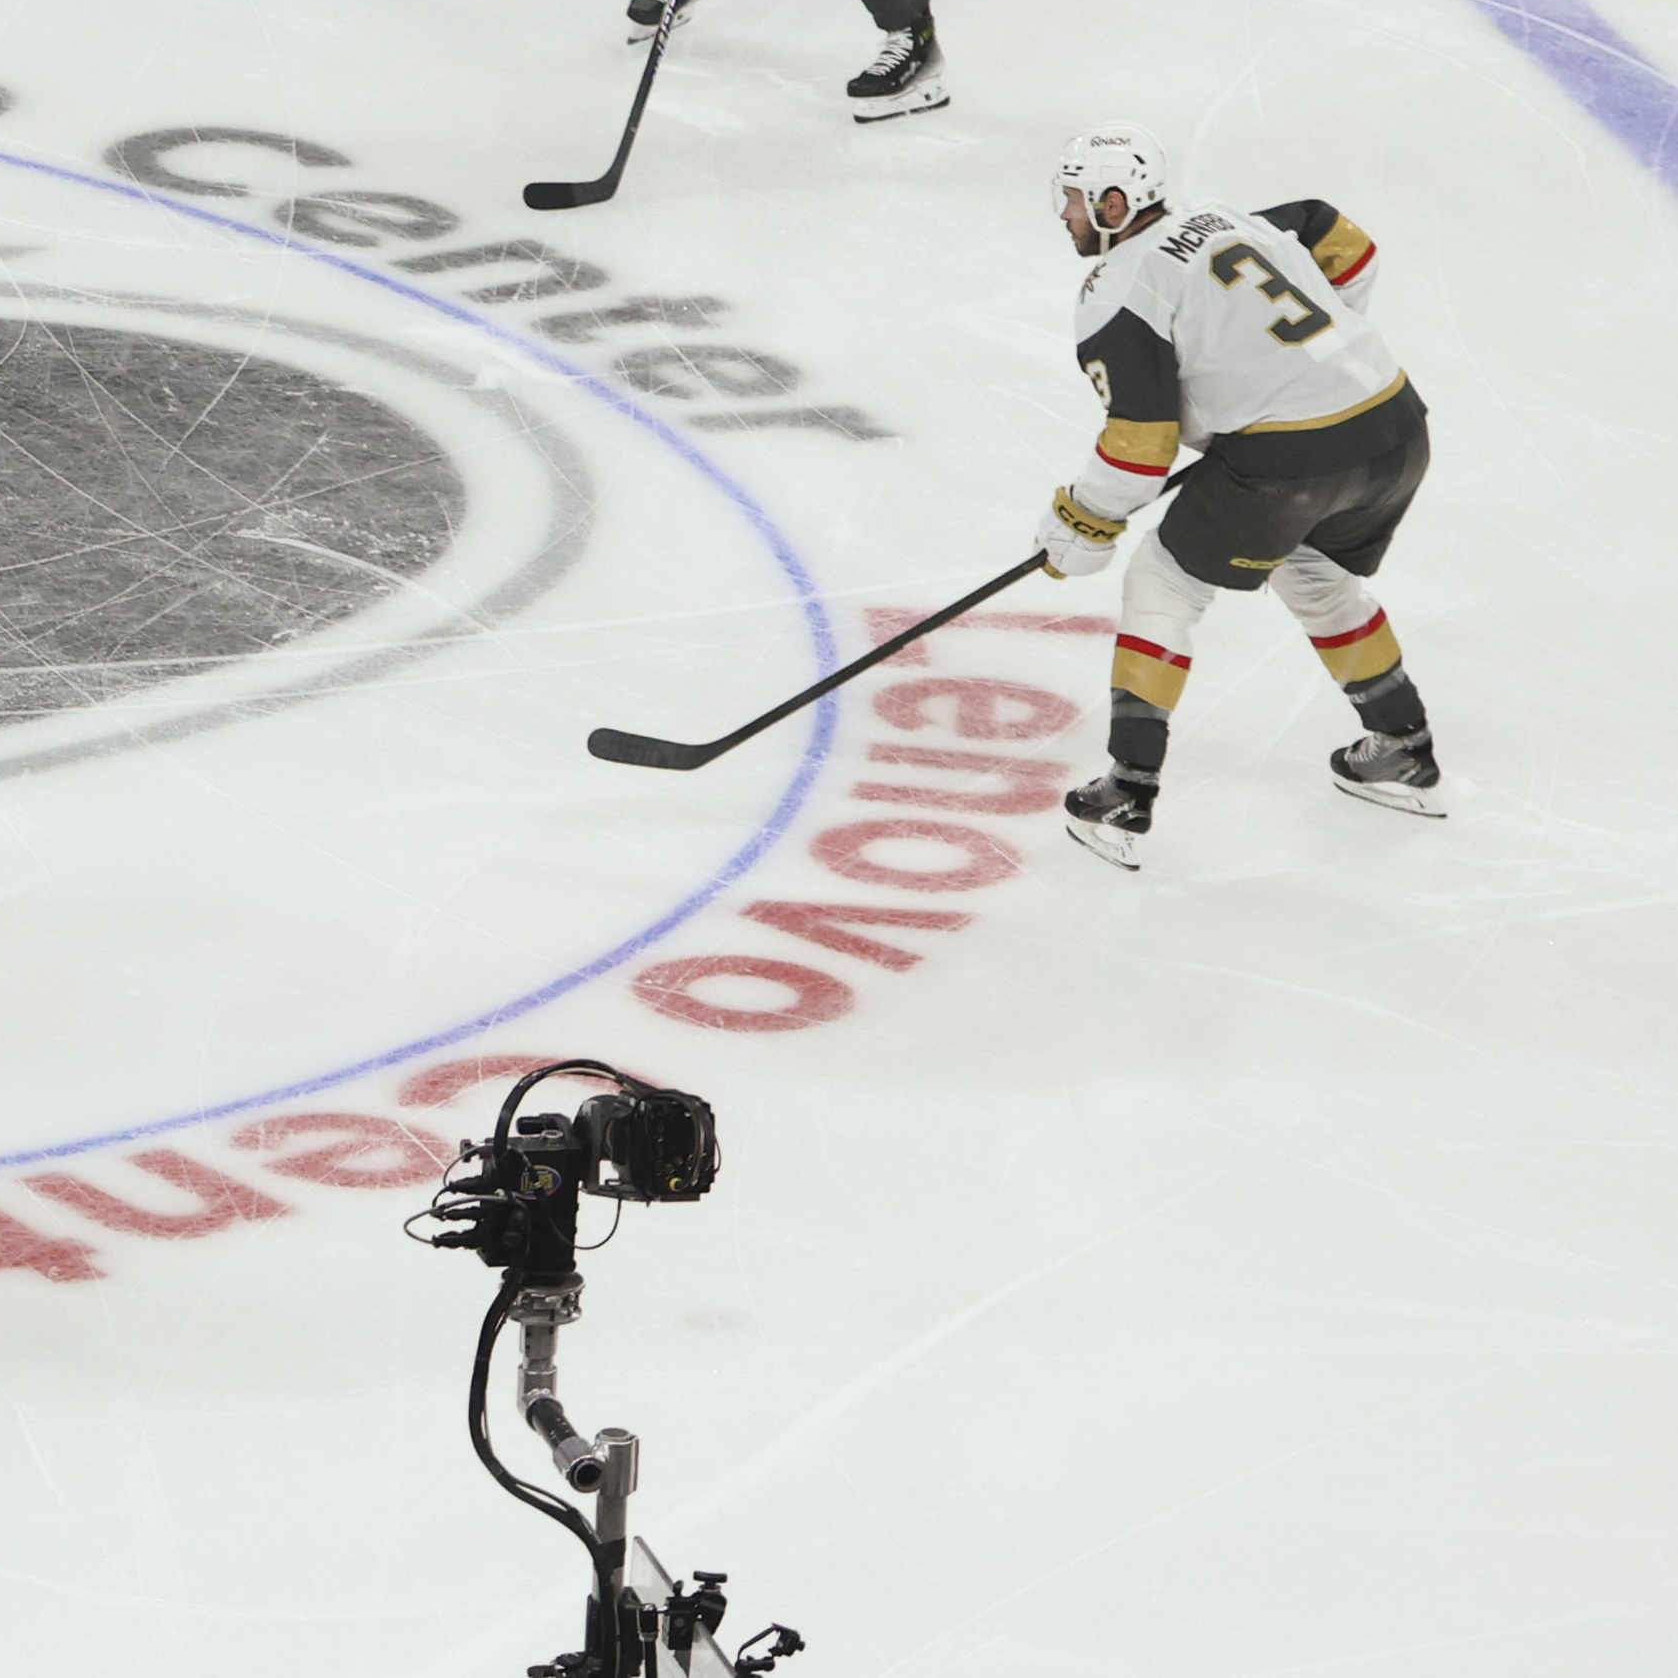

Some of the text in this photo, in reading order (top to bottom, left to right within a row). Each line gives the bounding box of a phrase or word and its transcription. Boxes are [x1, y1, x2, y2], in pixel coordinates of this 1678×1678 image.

[102, 125, 906, 443] Center
[1209, 241, 1335, 346] 3
[1057, 504, 1117, 540] CCM
